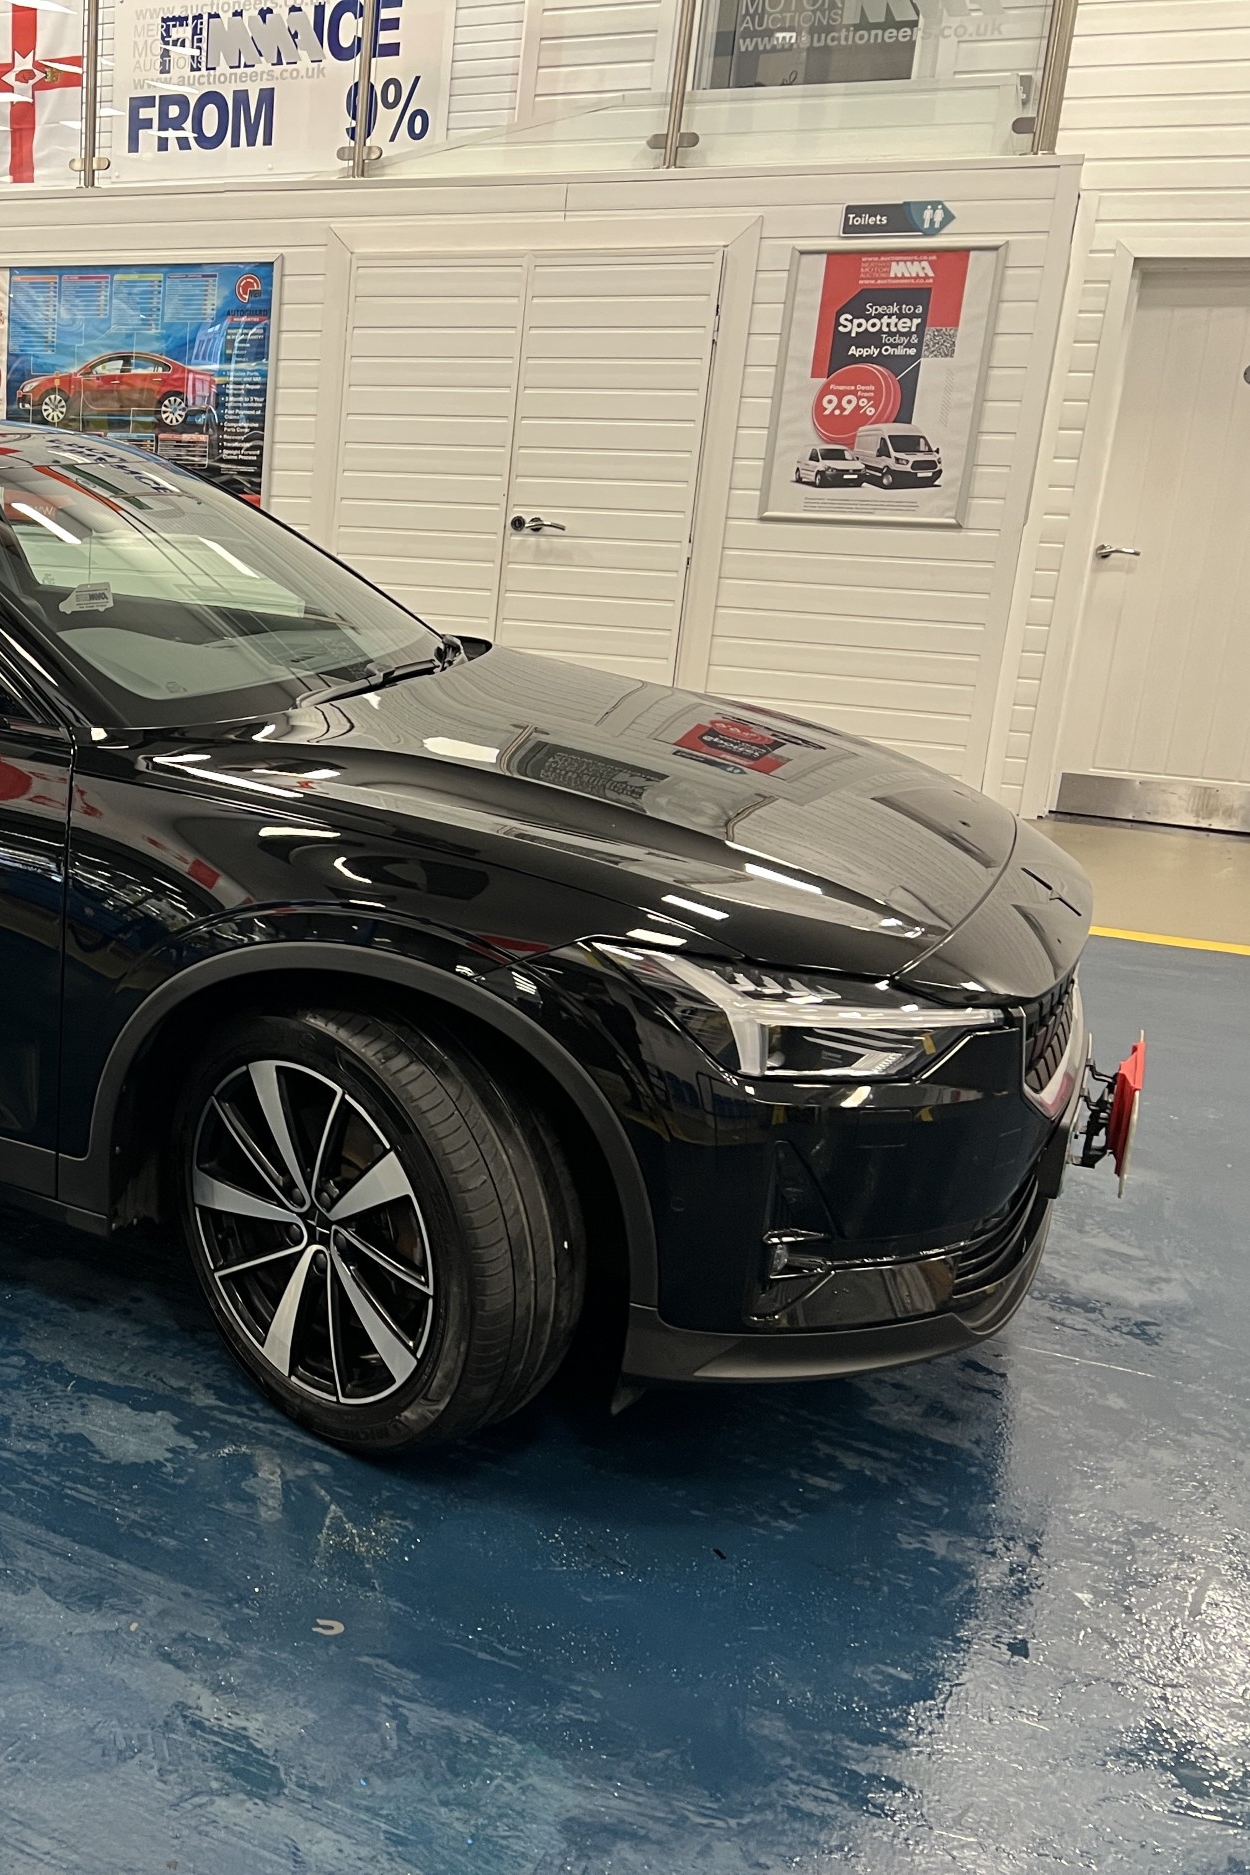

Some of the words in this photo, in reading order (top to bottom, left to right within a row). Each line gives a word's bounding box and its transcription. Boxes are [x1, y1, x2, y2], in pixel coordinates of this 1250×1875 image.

[740, 10, 842, 31] AUCTIONS
[159, 0, 401, 74] FICE
[128, 87, 275, 153] FROM
[345, 75, 430, 143] 9%
[848, 213, 888, 225] Toilets
[866, 302, 900, 316] Speak
[902, 304, 913, 313] to
[916, 305, 923, 313] a
[838, 313, 921, 337] Spotter
[881, 334, 909, 346] Today
[910, 334, 918, 343] &
[848, 346, 880, 357] Apply
[882, 346, 916, 355] Online
[822, 394, 876, 416] 9.9%
